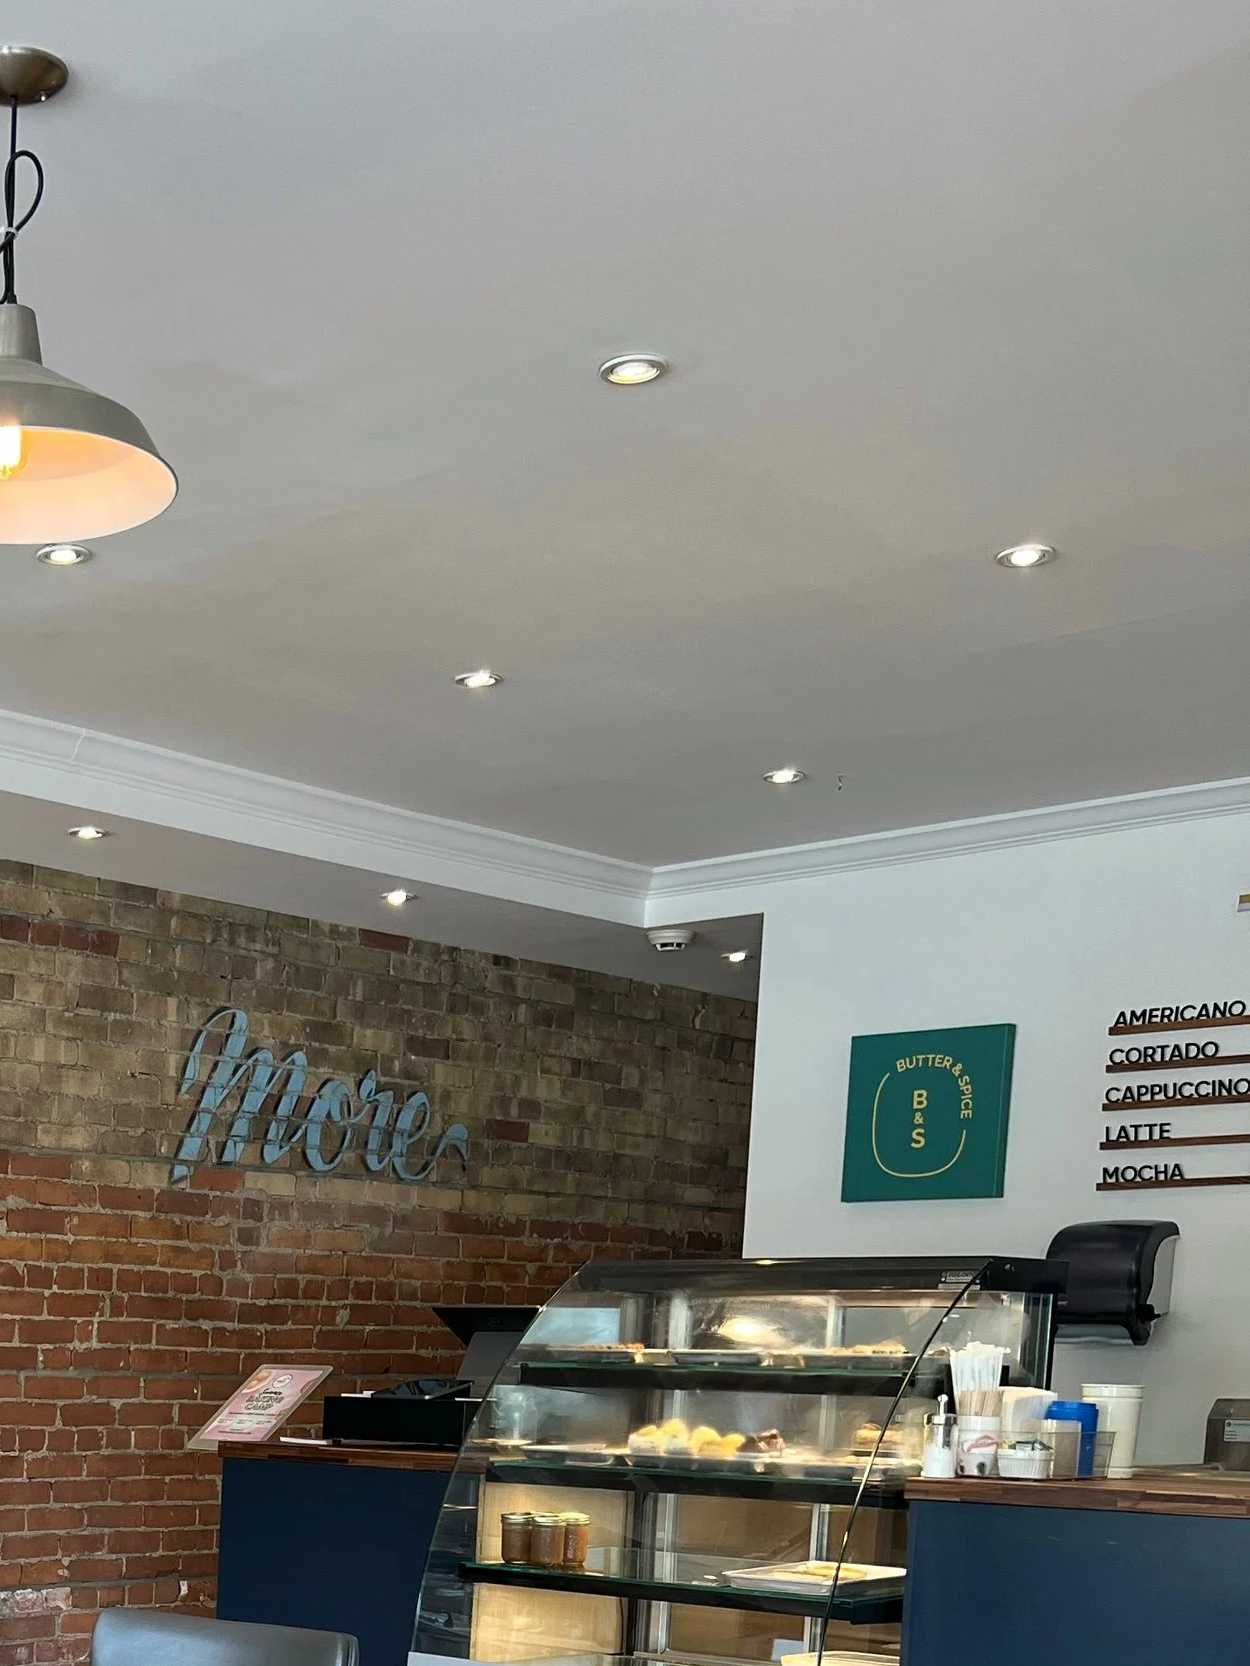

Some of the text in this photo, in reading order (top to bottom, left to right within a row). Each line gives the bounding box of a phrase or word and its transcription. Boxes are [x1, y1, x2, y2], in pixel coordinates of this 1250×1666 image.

[1113, 1000, 1246, 1027] AMERICANO
[1109, 1041, 1219, 1066] CORTADO
[896, 1054, 972, 1119] BUTTER & SPICE
[1105, 1078, 1250, 1103] CAPPUCCINO
[911, 1090, 928, 1149] B & S
[1105, 1123, 1170, 1142] LATTE
[1102, 1164, 1183, 1183] MOCHA
